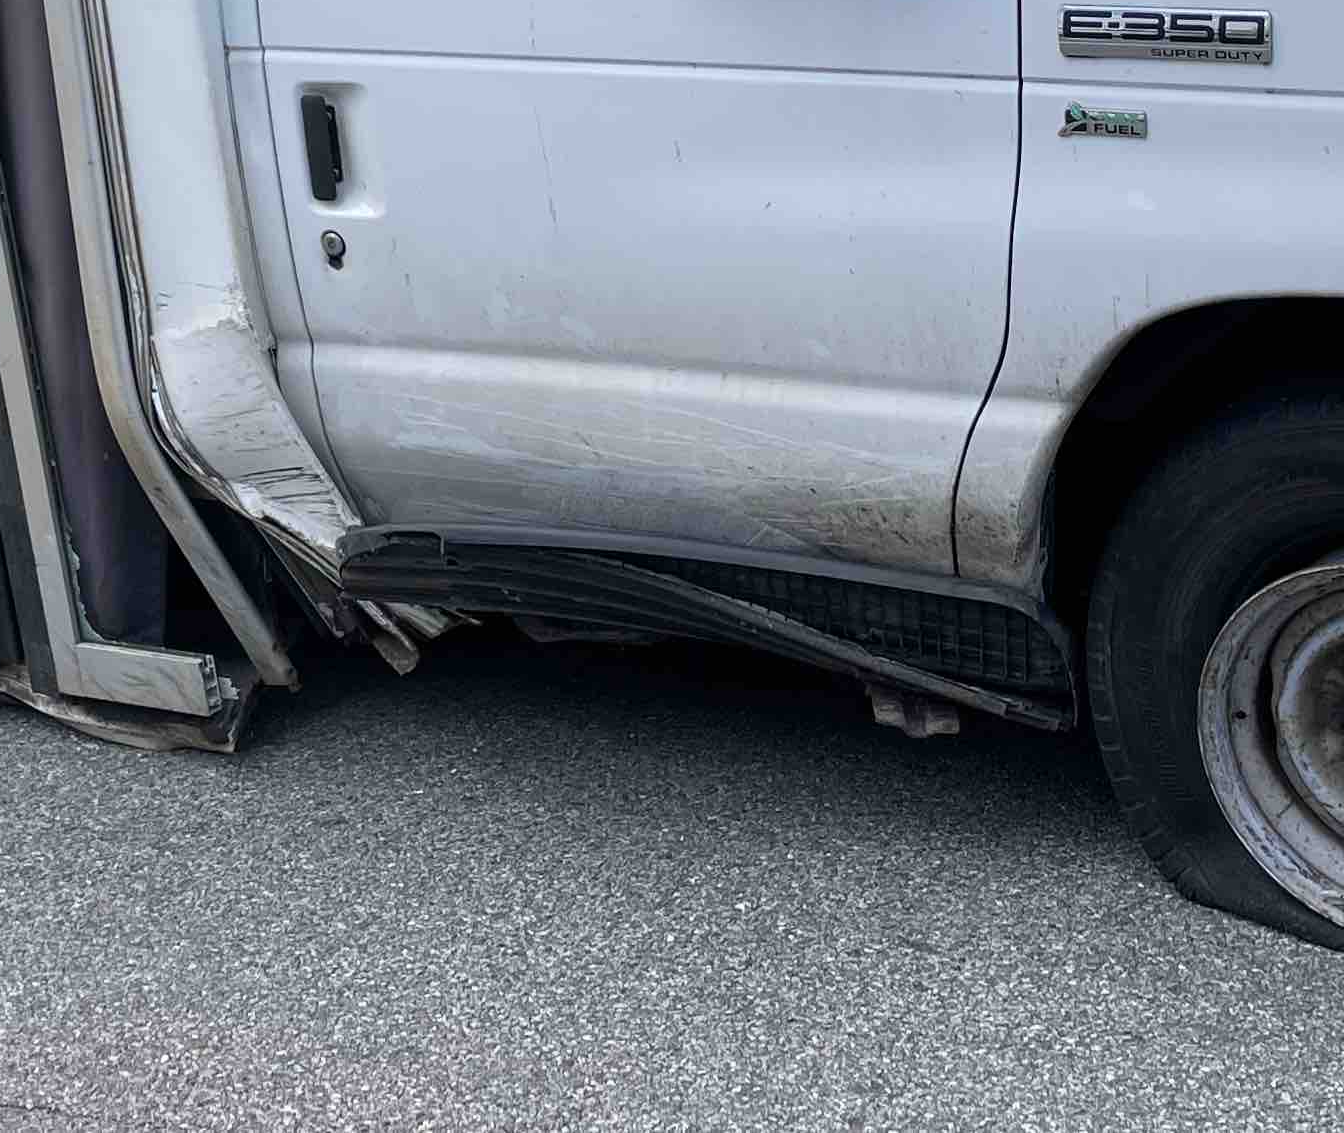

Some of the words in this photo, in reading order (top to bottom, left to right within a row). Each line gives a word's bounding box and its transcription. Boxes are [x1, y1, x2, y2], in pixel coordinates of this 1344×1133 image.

[1062, 9, 1266, 44] E-350
[1150, 47, 1210, 60] SUPER
[1214, 49, 1264, 61] DUTY
[1093, 122, 1142, 137] FUEL
